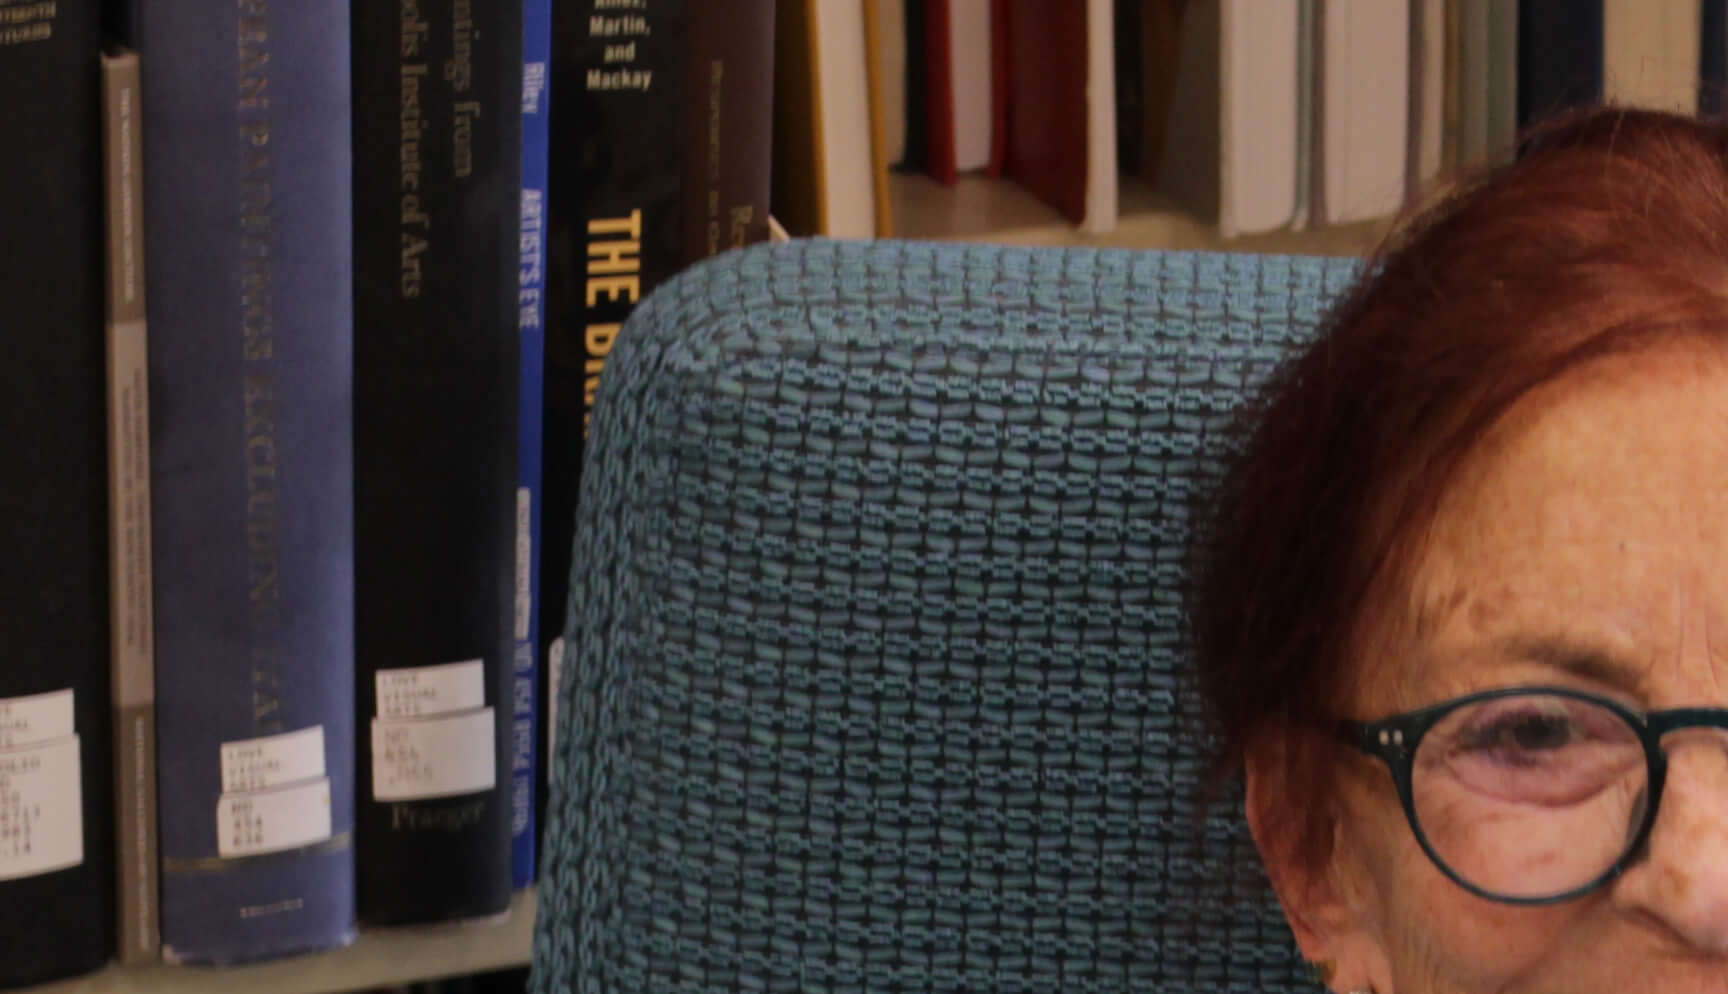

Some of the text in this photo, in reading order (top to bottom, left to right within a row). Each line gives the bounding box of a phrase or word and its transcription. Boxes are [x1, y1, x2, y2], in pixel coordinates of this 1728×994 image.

[589, 14, 652, 38] Martin,
[603, 40, 637, 65] and
[586, 67, 654, 94] Mackay
[399, 63, 429, 191] Institute
[452, 100, 481, 179] from
[400, 194, 430, 231] of
[399, 232, 430, 300] Arts
[585, 207, 642, 308] THE
